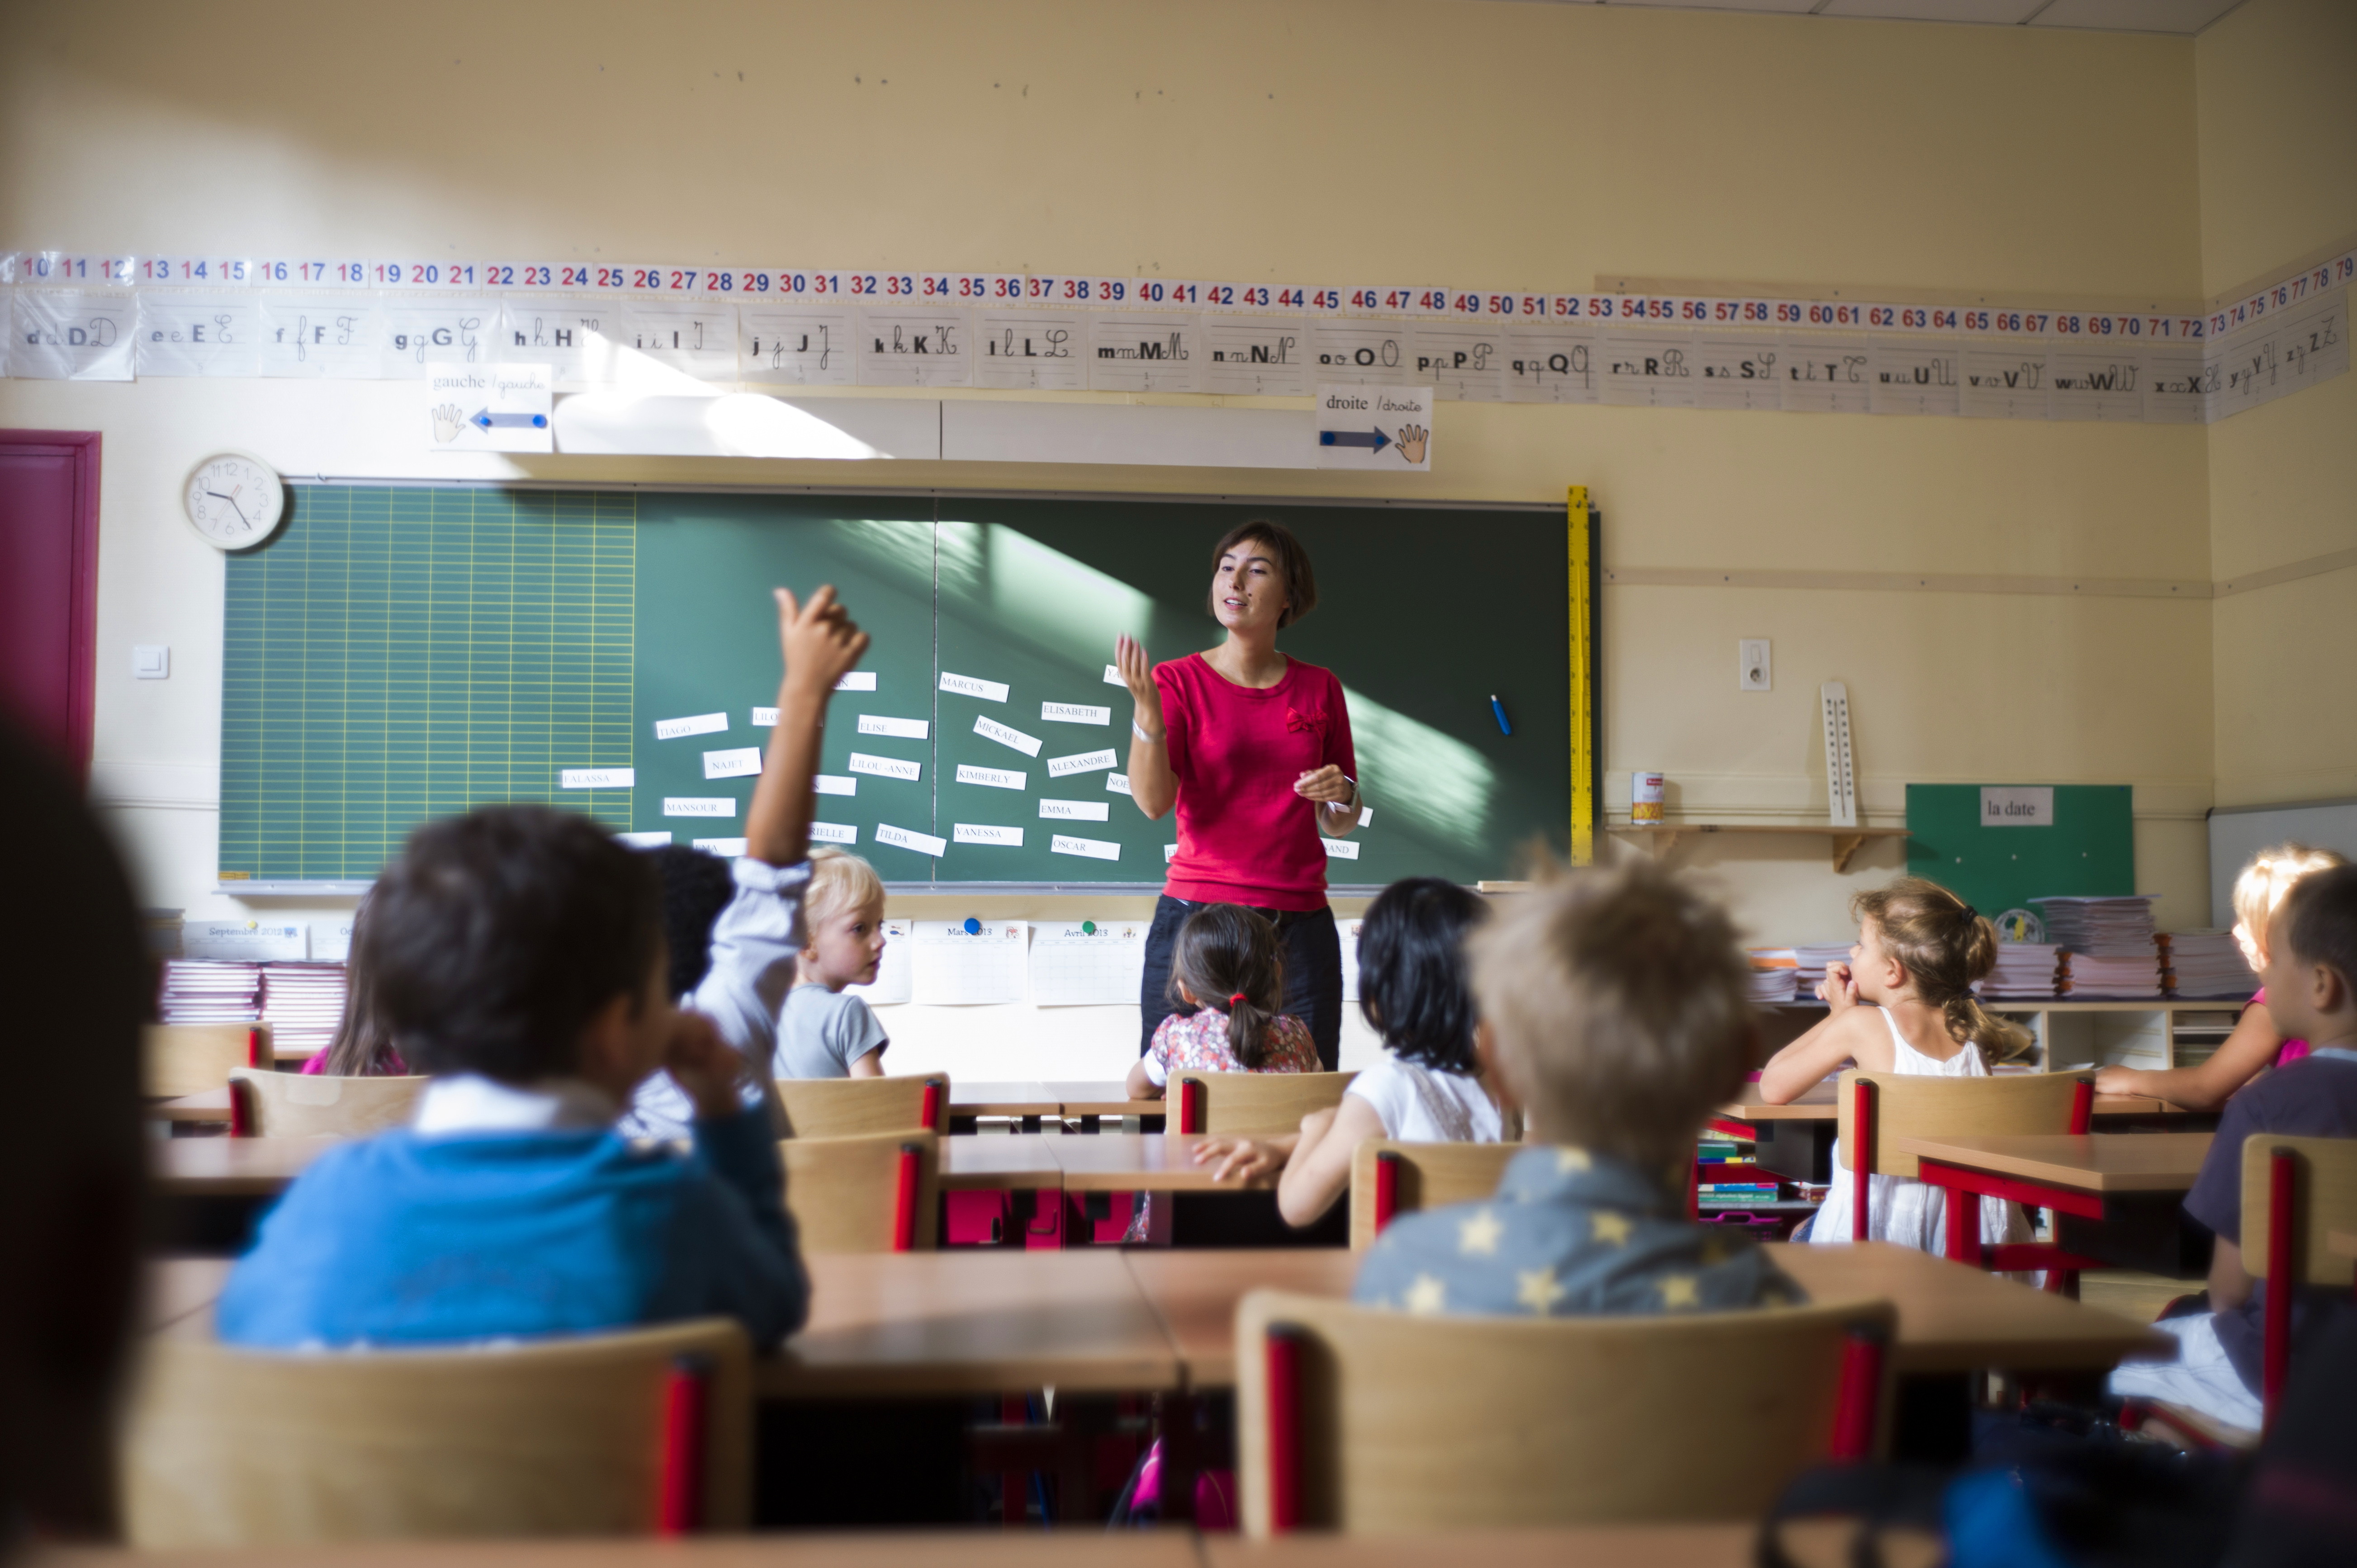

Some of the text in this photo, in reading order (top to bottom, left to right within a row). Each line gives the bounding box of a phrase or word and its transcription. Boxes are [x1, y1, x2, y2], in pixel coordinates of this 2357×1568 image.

[24, 257, 2353, 337] 10 11 12 13 14 15 16 17 18 19 20 21 22 23 24 25 26 27 28 29 30 31 32 33 34 35 36 37 38 39 40 41 42 43 44 45 46 47 48 49 50 51 52 53 54 55 56 57 58 59 60 61 62 63 64 65 66 67 68 69 70 71 72 73 74 75 76 77 78 79
[193, 325, 205, 342] E
[315, 326, 326, 343] F
[432, 328, 452, 346] G
[914, 336, 928, 354] K
[2310, 333, 2319, 352] Z
[1355, 348, 1375, 366] O
[1548, 354, 1569, 374] Q
[1825, 364, 1837, 381] T
[1915, 367, 1929, 383] U
[433, 375, 485, 390] gauche
[1327, 395, 1368, 409] droite
[224, 463, 237, 476] 12
[196, 477, 210, 491] 10
[255, 477, 263, 490] 2
[193, 491, 201, 504] 9
[260, 493, 268, 507] 3
[198, 505, 206, 520] 8
[253, 510, 262, 522] 4
[226, 522, 234, 535] 6
[942, 677, 983, 692] MARCUS
[1044, 705, 1097, 717] ELISABETH
[658, 725, 691, 737] TIAGO
[861, 723, 887, 732] ELISE
[977, 721, 1018, 744] MICKAEL
[713, 760, 743, 770] NAJET
[1051, 755, 1110, 772] ALEXANDRE
[564, 775, 610, 783] FALASSA
[959, 770, 1010, 783] KIMBERLY
[667, 804, 717, 812] MANSOUR
[1041, 806, 1071, 814] EMMA
[1988, 800, 2035, 817] la date
[880, 829, 907, 843] TILDA
[956, 828, 1001, 837] VANESSA
[1054, 840, 1085, 851] OSCAR
[209, 928, 258, 937] Septembre
